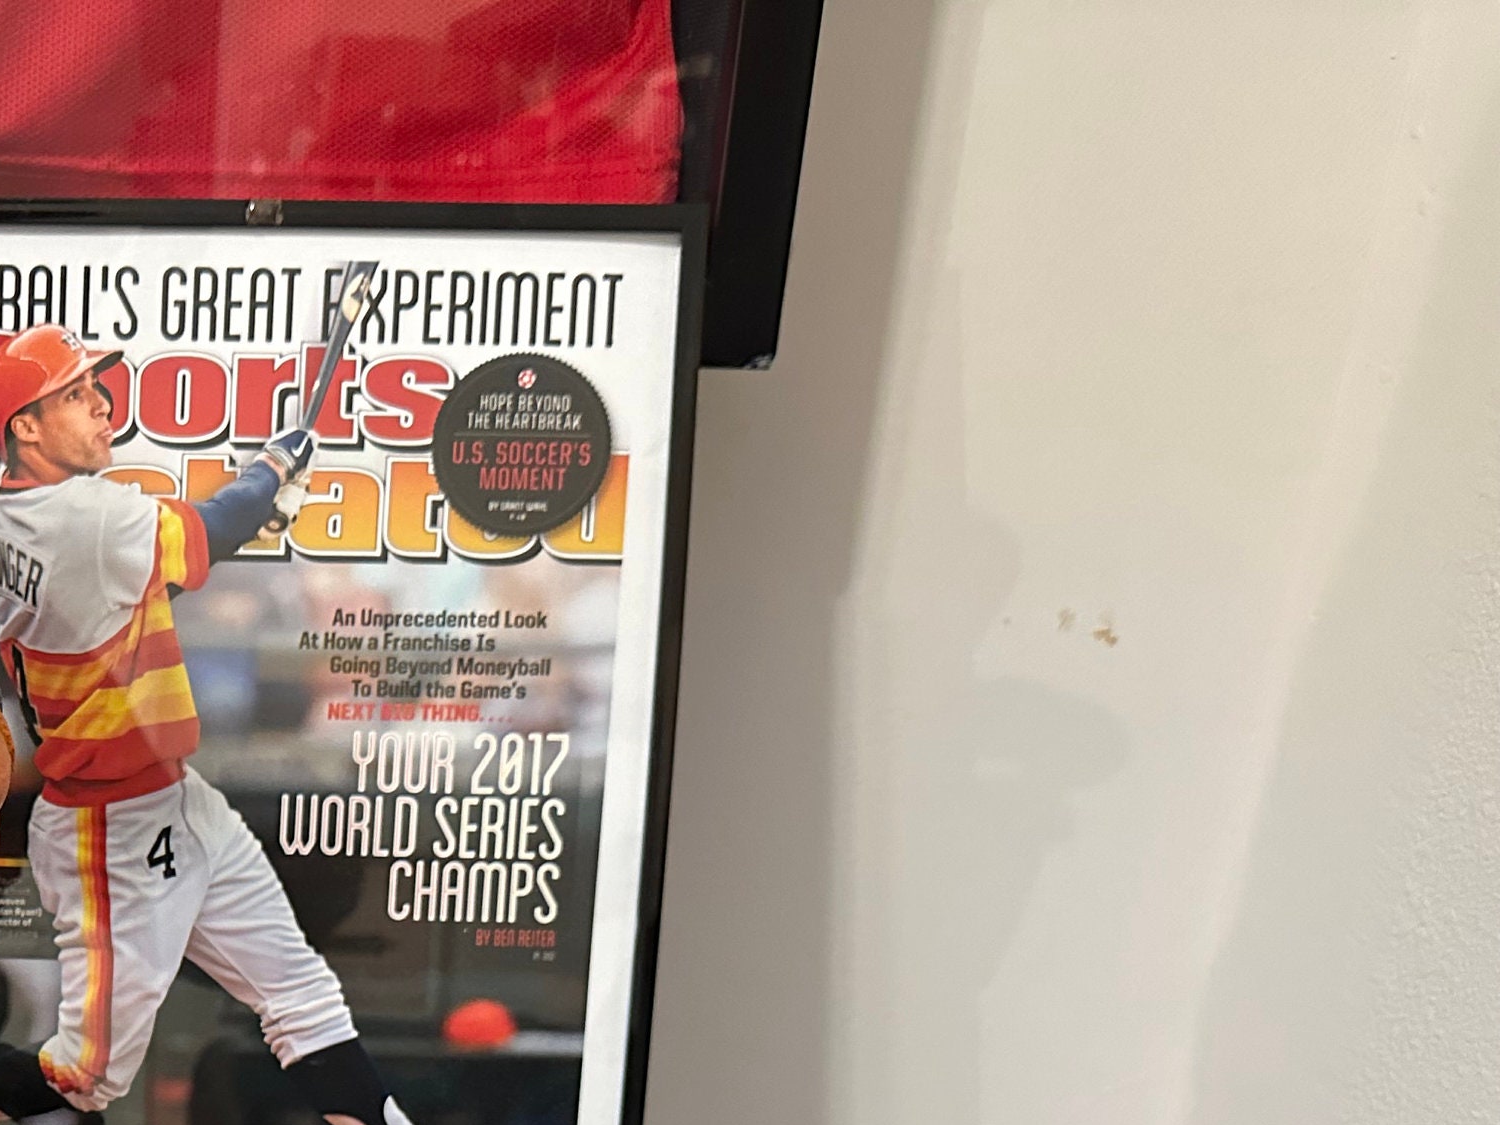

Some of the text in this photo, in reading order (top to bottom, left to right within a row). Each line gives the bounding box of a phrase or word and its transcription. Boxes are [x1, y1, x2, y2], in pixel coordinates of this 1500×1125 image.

[161, 266, 302, 343] GREAT
[479, 393, 572, 413] HOPE BEYOND
[467, 411, 583, 431] THE HEARTBREAK
[452, 441, 592, 466] U.S. SOCCER'S
[478, 466, 568, 491] MOMENT
[332, 608, 548, 631] An Unprecedented Look
[299, 631, 496, 651] At How a Franchise Is
[330, 656, 551, 680] Going Beyond Moneyball
[351, 679, 527, 700] To Build the Game's
[327, 703, 375, 721] NEXT
[379, 703, 416, 722] BIG
[352, 730, 571, 796] YOUR 2017
[278, 793, 566, 861] WORLD SERIES
[146, 825, 177, 879] 4
[387, 860, 561, 925] CHAMPS
[22, 917, 32, 927] of
[475, 929, 556, 947] BY BEN REITER
